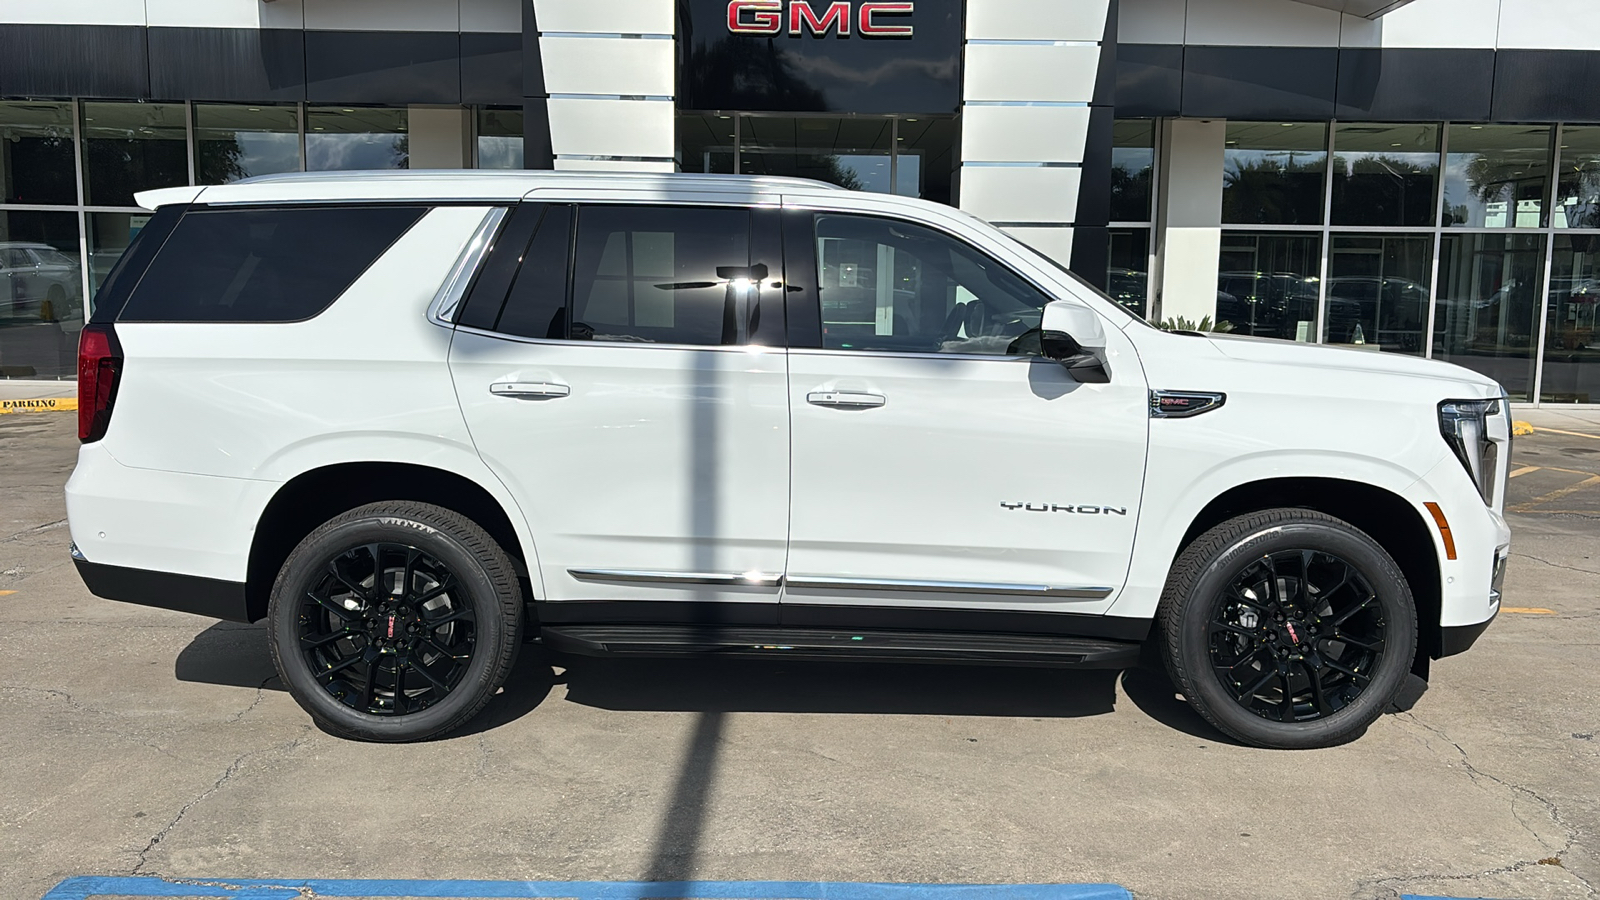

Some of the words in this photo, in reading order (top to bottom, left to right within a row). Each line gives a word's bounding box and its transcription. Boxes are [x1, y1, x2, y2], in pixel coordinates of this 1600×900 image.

[727, 0, 914, 36] GMC
[2, 399, 56, 408] PARKING
[1161, 397, 1189, 406] GMC
[1000, 501, 1127, 516] YUKON
